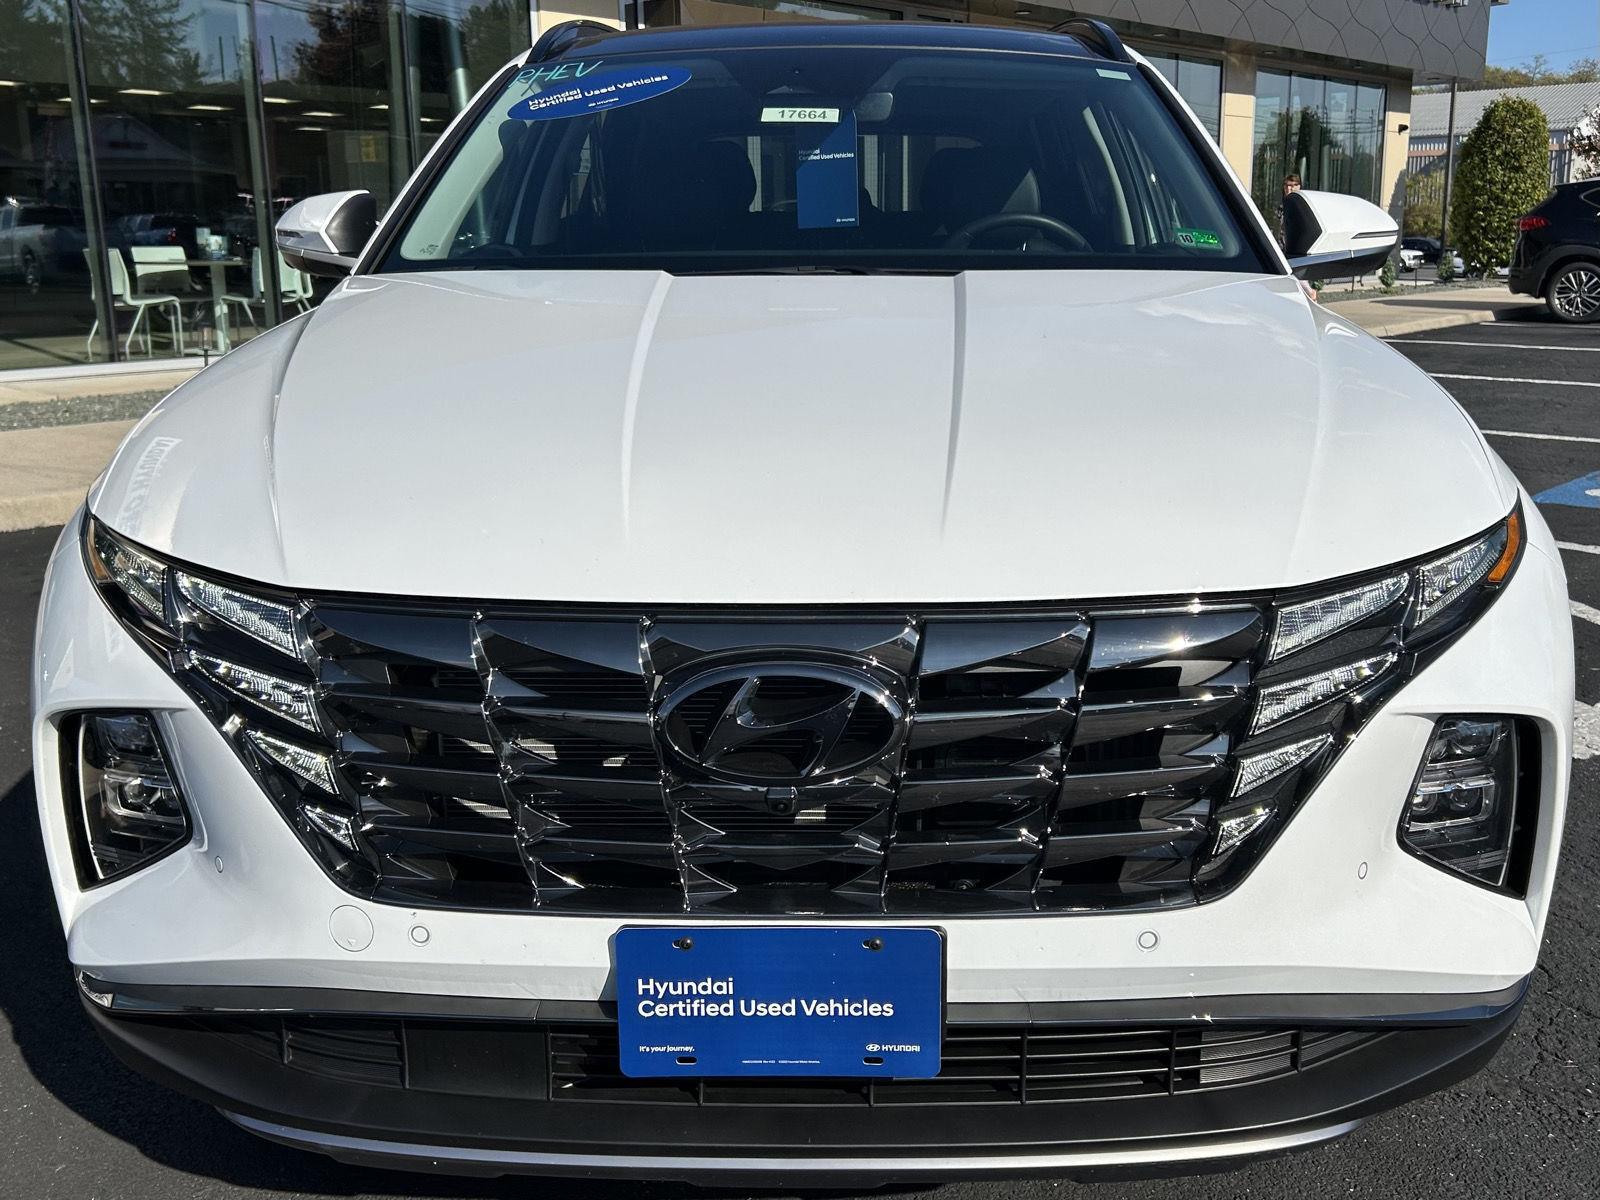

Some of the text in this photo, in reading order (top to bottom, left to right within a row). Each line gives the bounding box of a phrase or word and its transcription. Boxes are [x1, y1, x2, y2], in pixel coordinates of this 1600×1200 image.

[508, 61, 603, 96] PHEV
[529, 88, 581, 106] Hyundai
[530, 74, 669, 110] Certified Used Vehicles
[778, 109, 828, 120] 17664
[1179, 234, 1193, 244] 10
[637, 978, 734, 999] Hyundai
[637, 998, 894, 1018] Certified Used Vehicles
[666, 1045, 695, 1053] journey.
[881, 1044, 921, 1052] HYUNDAI
